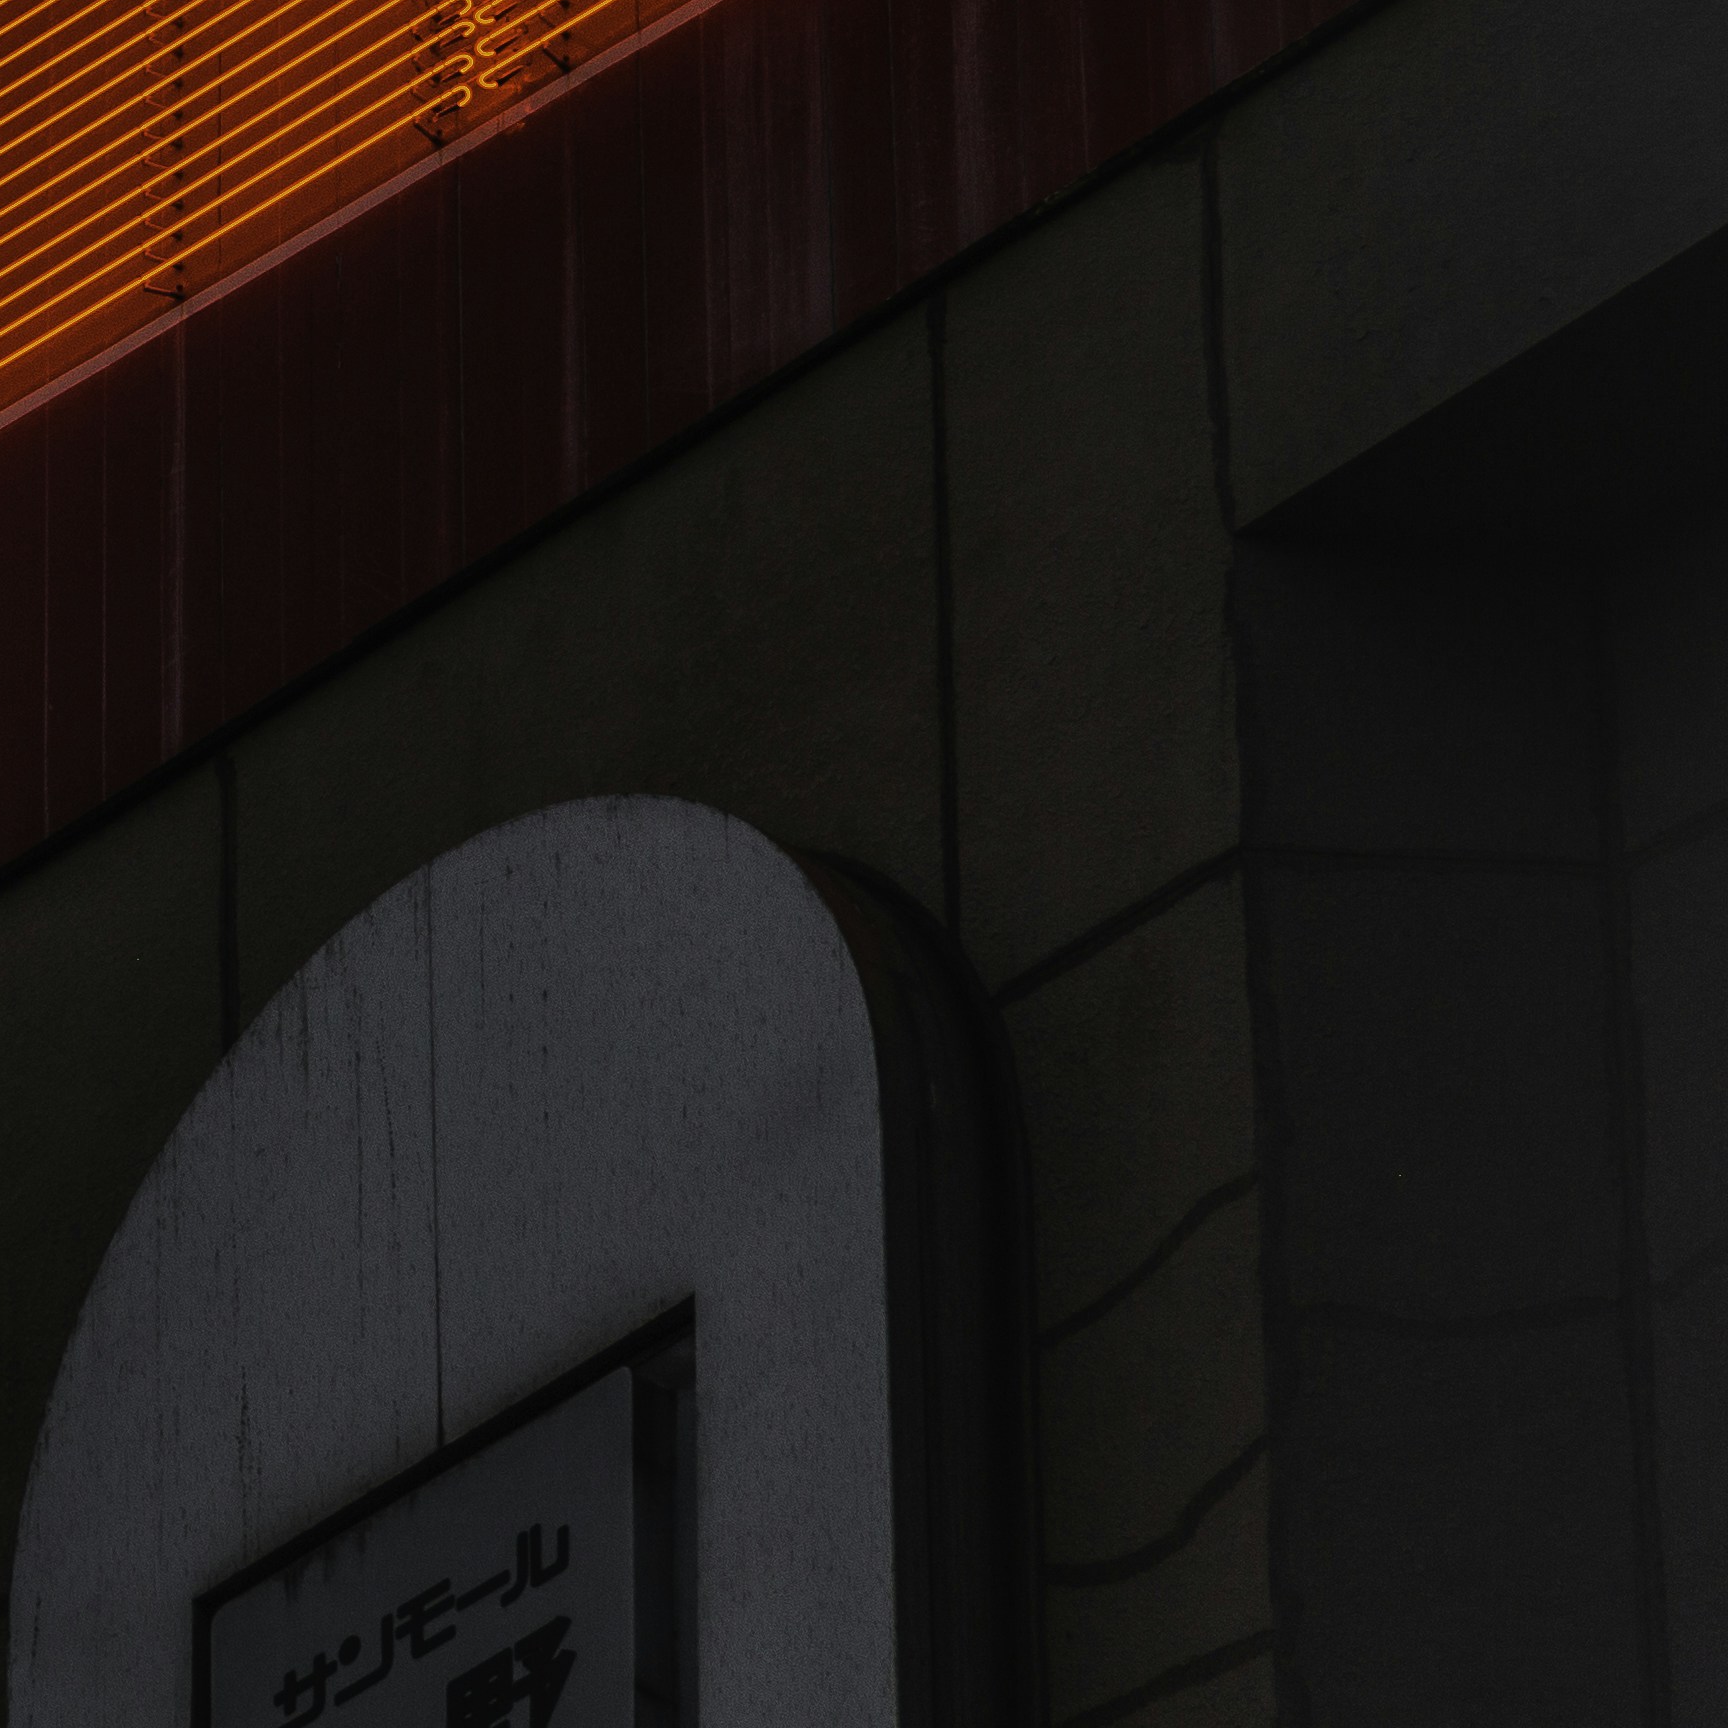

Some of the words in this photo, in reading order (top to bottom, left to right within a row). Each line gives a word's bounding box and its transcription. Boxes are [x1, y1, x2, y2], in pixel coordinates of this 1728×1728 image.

[272, 1522, 570, 1728] サンモール
